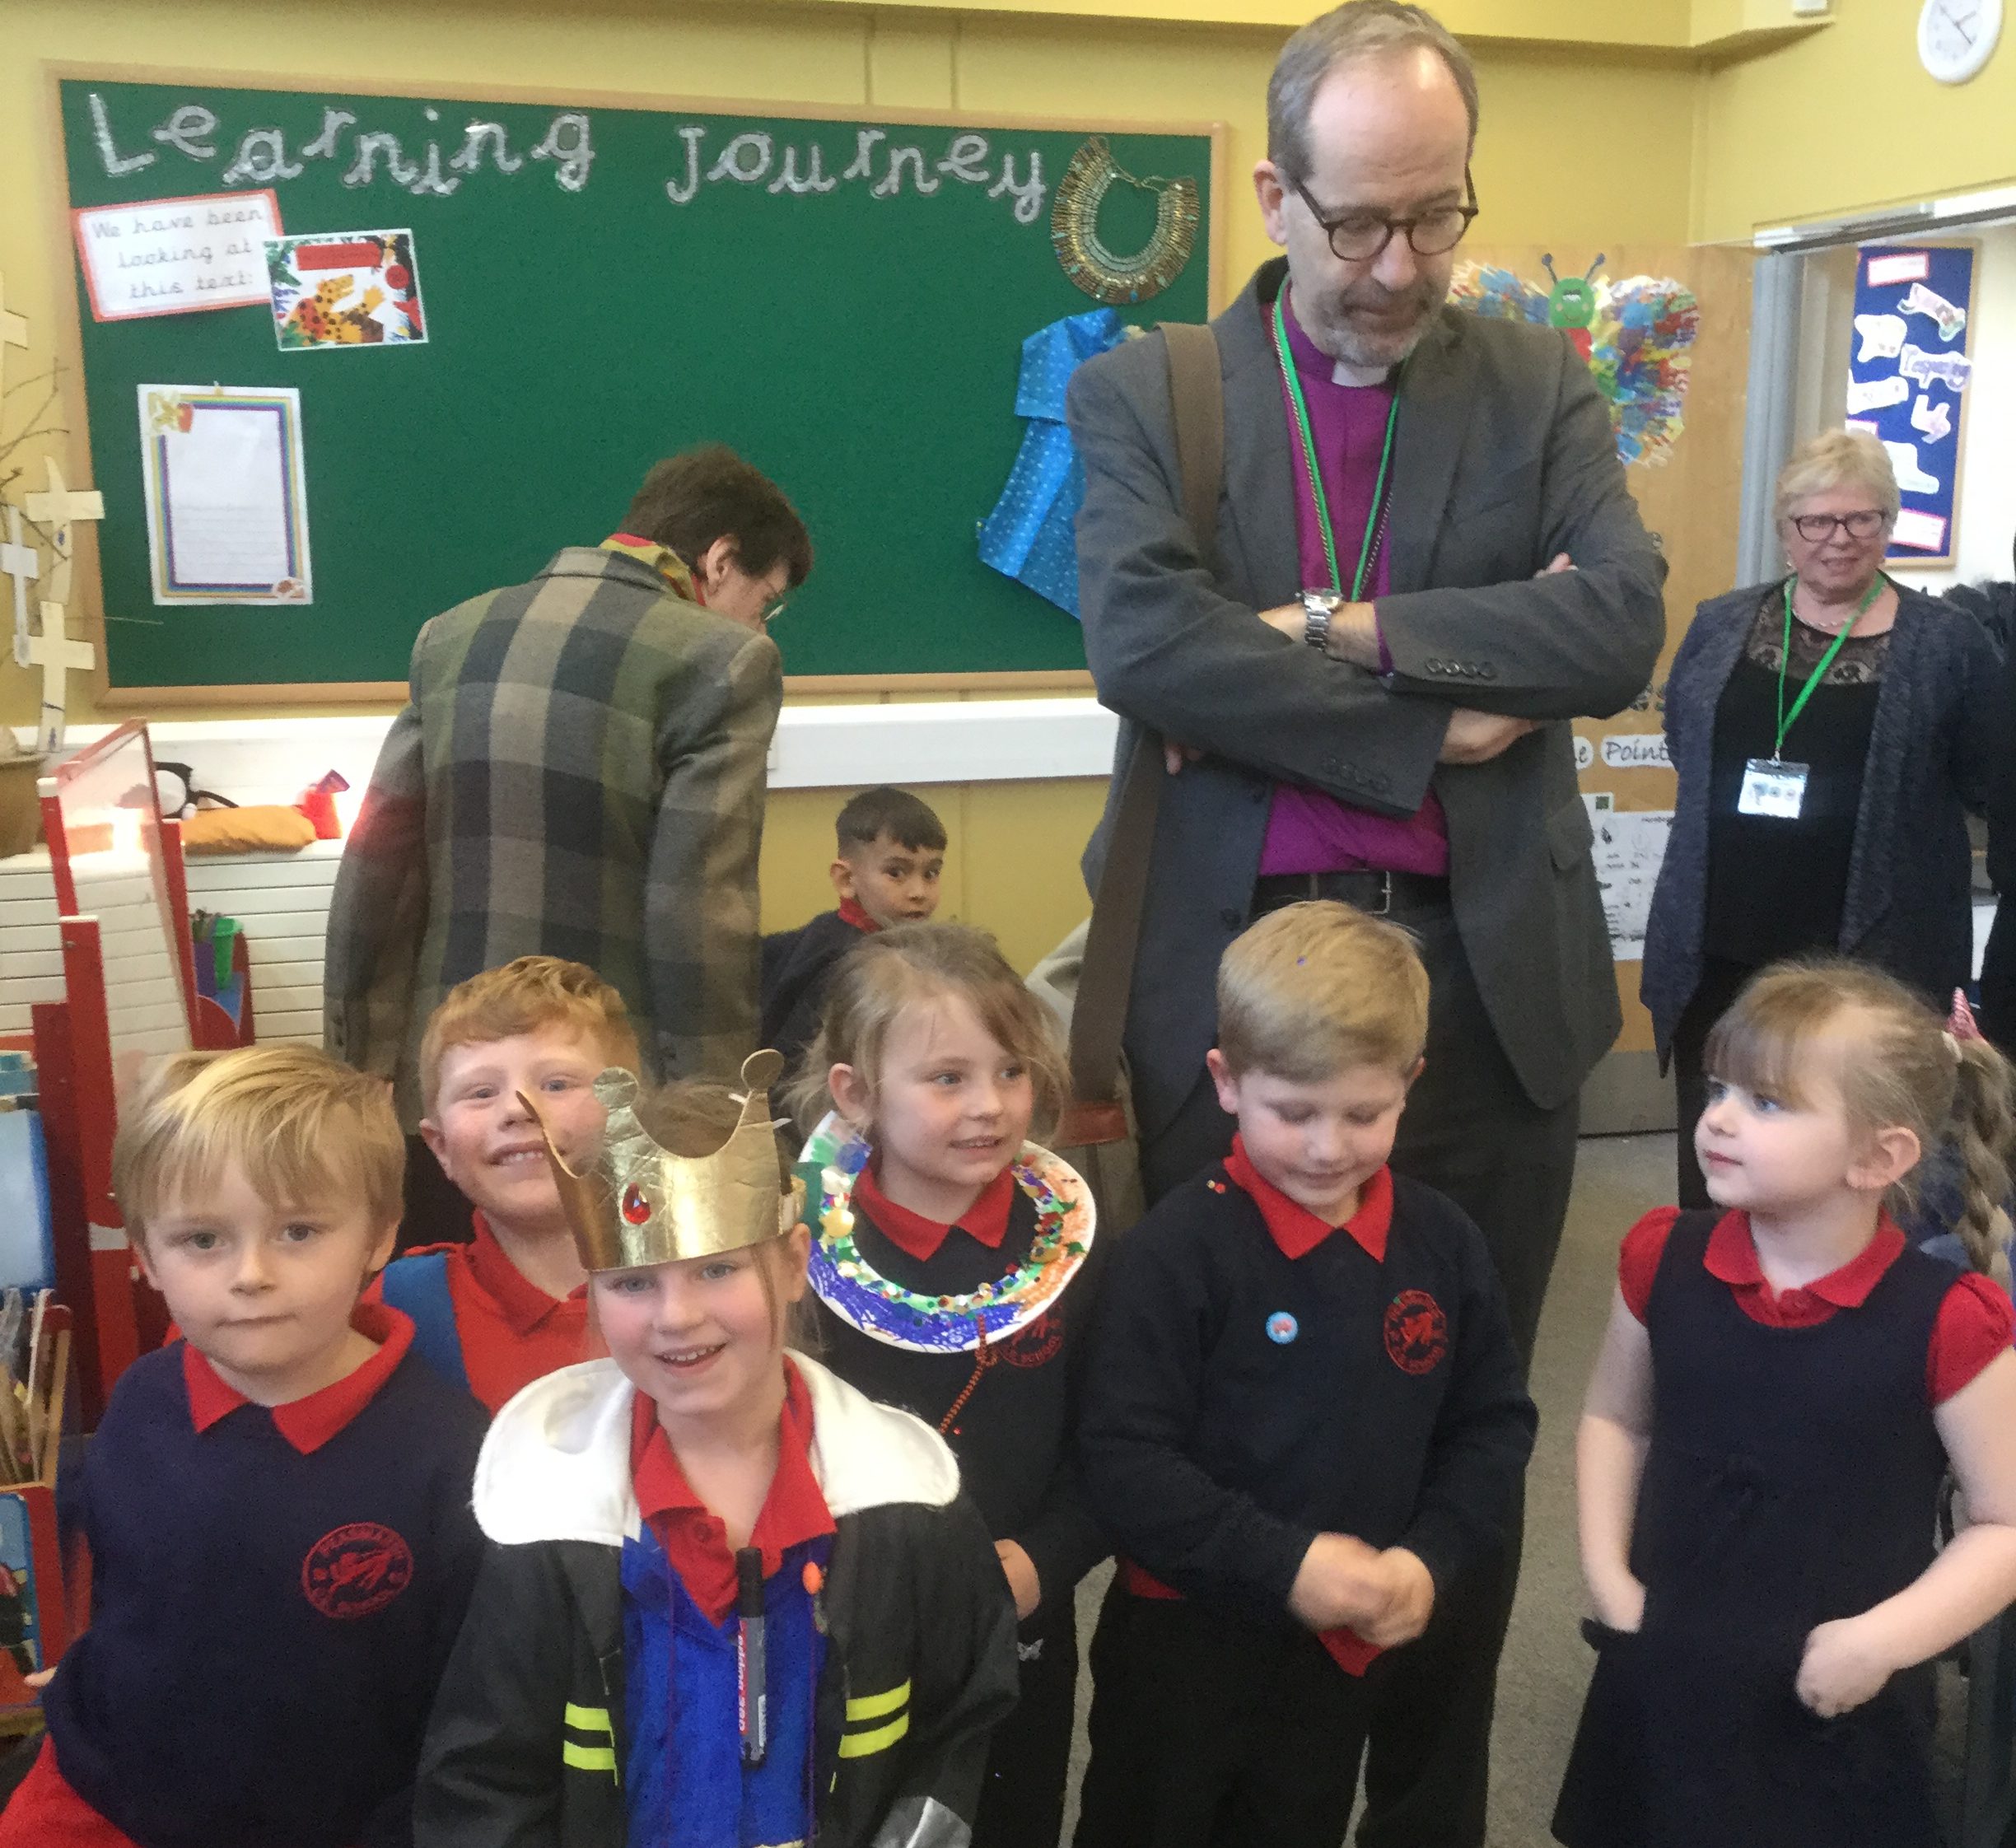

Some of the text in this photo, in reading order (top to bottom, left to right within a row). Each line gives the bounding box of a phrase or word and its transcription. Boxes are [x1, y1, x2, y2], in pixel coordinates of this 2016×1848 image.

[88, 93, 1048, 224] Learning Journey
[92, 208, 263, 239] We have been
[226, 237, 252, 256] at
[129, 280, 184, 299] this
[1606, 738, 1668, 761] Point
